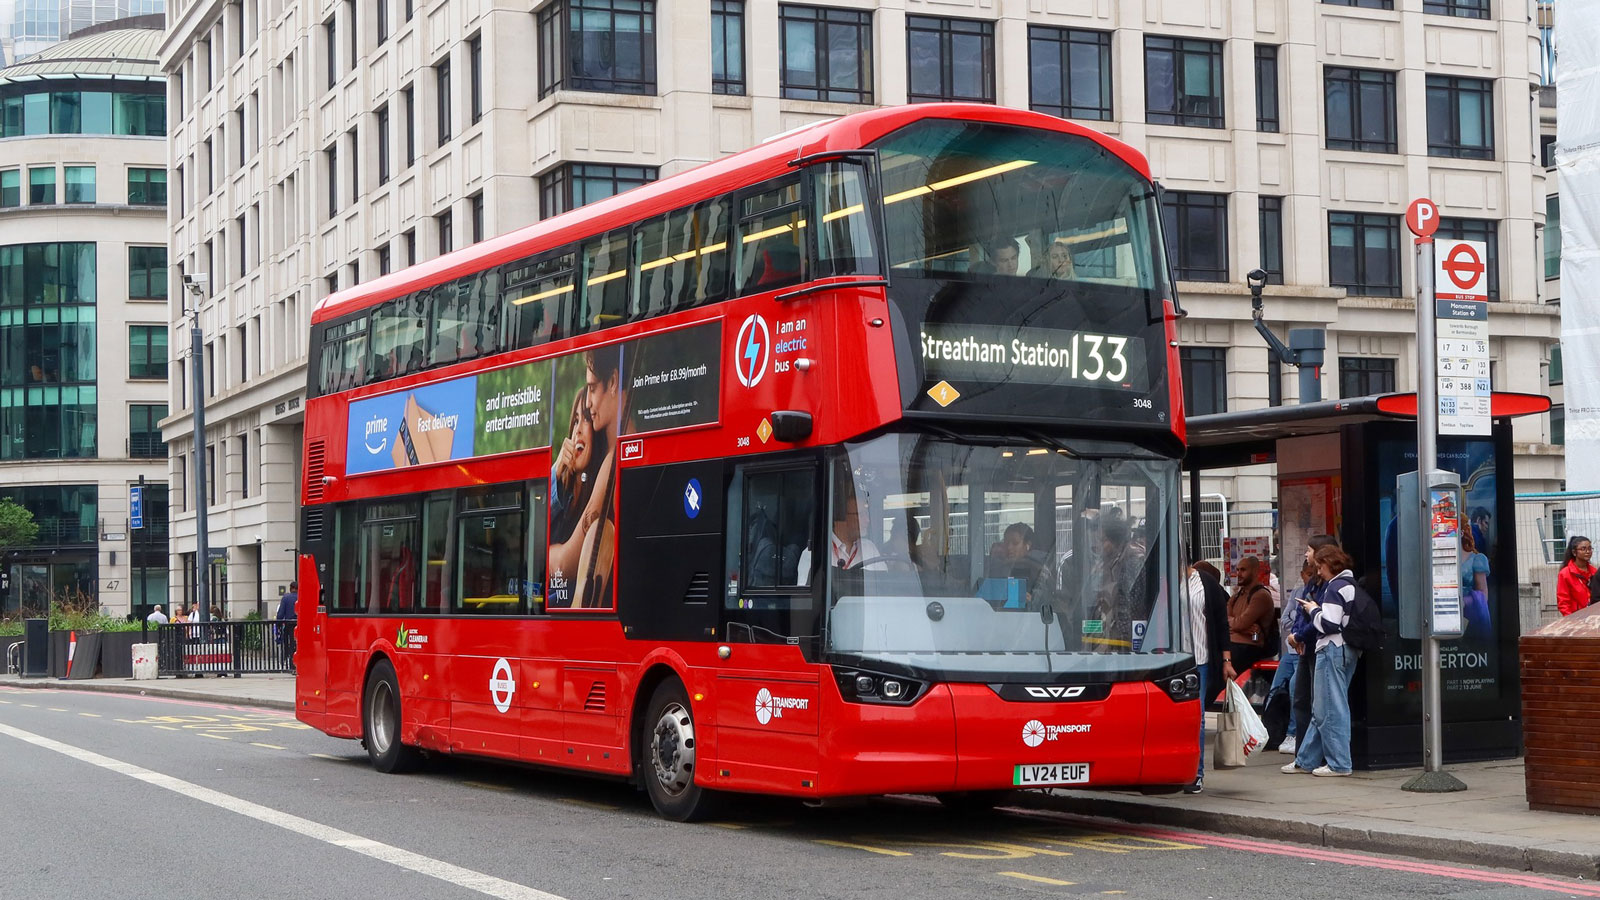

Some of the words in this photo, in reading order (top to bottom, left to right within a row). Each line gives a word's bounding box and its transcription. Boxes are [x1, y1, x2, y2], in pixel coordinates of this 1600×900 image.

[1416, 203, 1433, 230] P
[1450, 302, 1477, 311] Monument
[775, 321, 779, 335] I
[780, 322, 794, 334] am
[795, 319, 806, 332] an
[775, 336, 807, 354] electric
[920, 332, 1006, 364] Streatham
[1011, 335, 1069, 369] Station
[1442, 343, 1451, 351] 17
[1461, 344, 1469, 352] 21
[1477, 345, 1485, 353] 35
[1071, 333, 1128, 382] 133
[774, 359, 790, 374] bus
[1461, 363, 1469, 371] 47
[632, 376, 644, 388] Join
[644, 373, 660, 386] Prime
[660, 371, 669, 383] for
[669, 364, 707, 382] £8.99/month
[1441, 382, 1453, 390] 149
[1460, 382, 1472, 391] 388
[1477, 383, 1489, 391] N21
[485, 392, 500, 412] and
[501, 385, 541, 409] irresistible
[1132, 398, 1152, 410] 3048
[365, 414, 388, 439] prime
[417, 416, 431, 433] Fast
[432, 413, 459, 432] delivery
[485, 411, 540, 433] entertainment
[736, 436, 750, 447] 3048
[624, 444, 639, 457] global
[106, 581, 119, 591] 47
[550, 572, 564, 589] idea
[555, 589, 569, 604] you
[1394, 652, 1488, 671] BRIERTON
[772, 696, 809, 710] TRANSPORT
[773, 707, 783, 718] UK
[1046, 724, 1091, 734] TRANSPORT
[1046, 732, 1058, 741] UK
[1022, 766, 1058, 782] LV24
[1061, 765, 1087, 780] EUF
